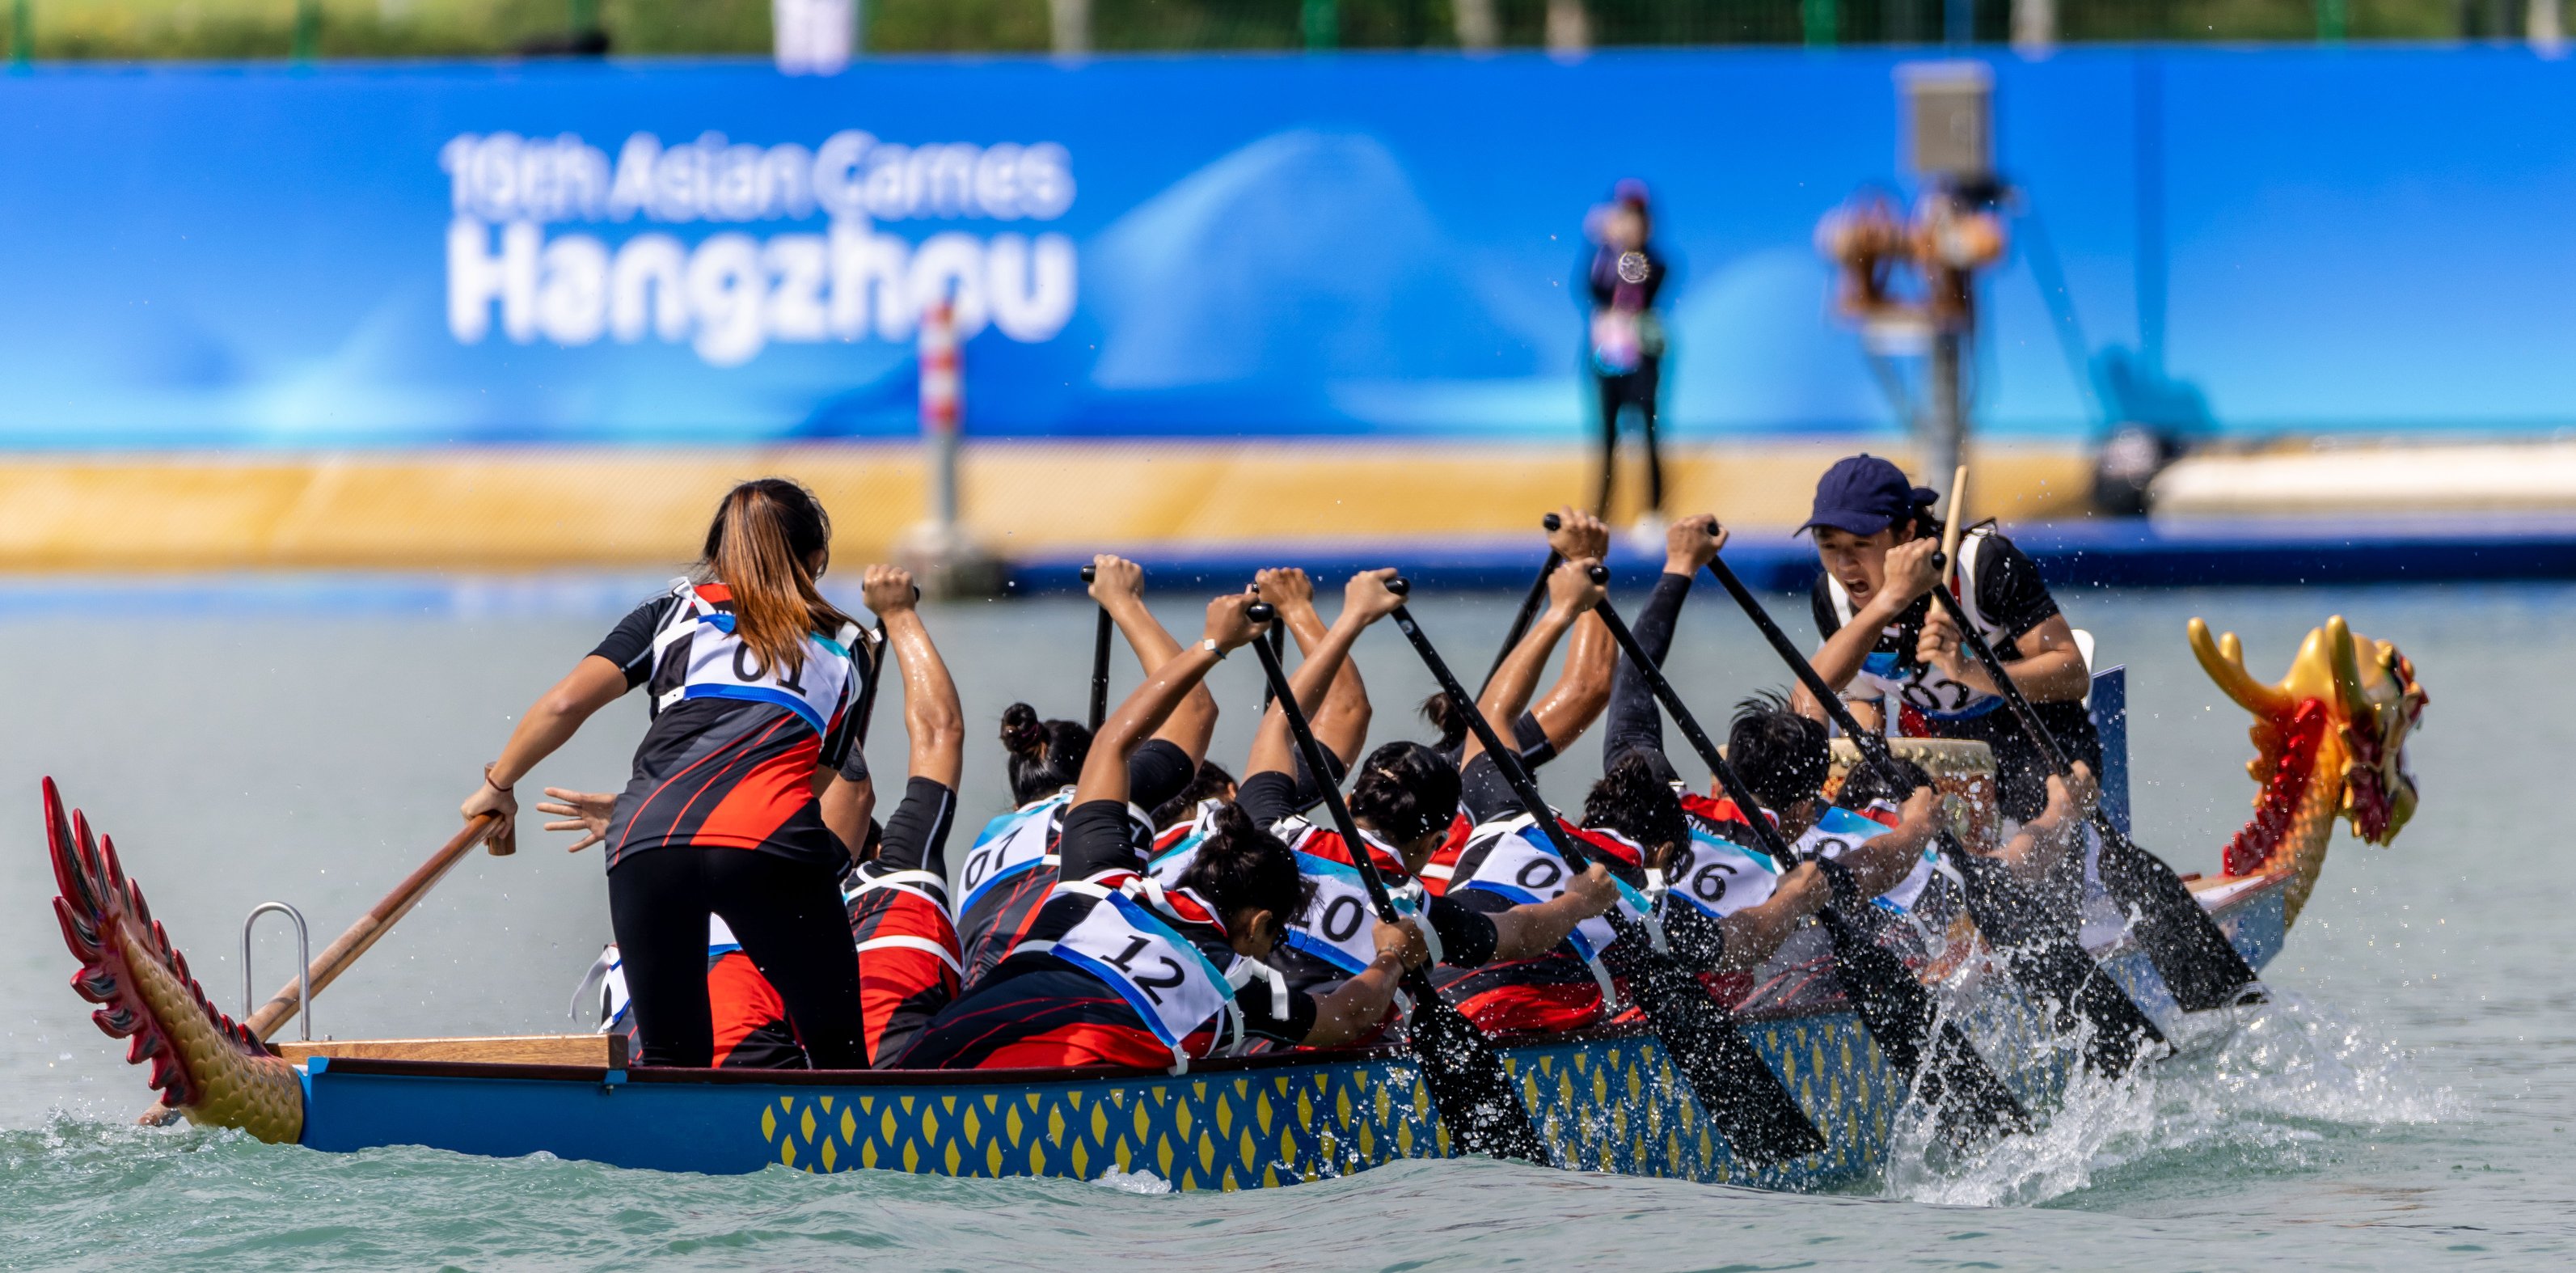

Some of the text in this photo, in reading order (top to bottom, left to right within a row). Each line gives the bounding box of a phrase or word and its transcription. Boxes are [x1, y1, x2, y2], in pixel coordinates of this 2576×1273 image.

[443, 131, 1076, 221] 19th Asian Games
[448, 215, 1077, 366] Hangzhou
[965, 826, 1024, 891] 07
[1099, 934, 1185, 1006] 12
